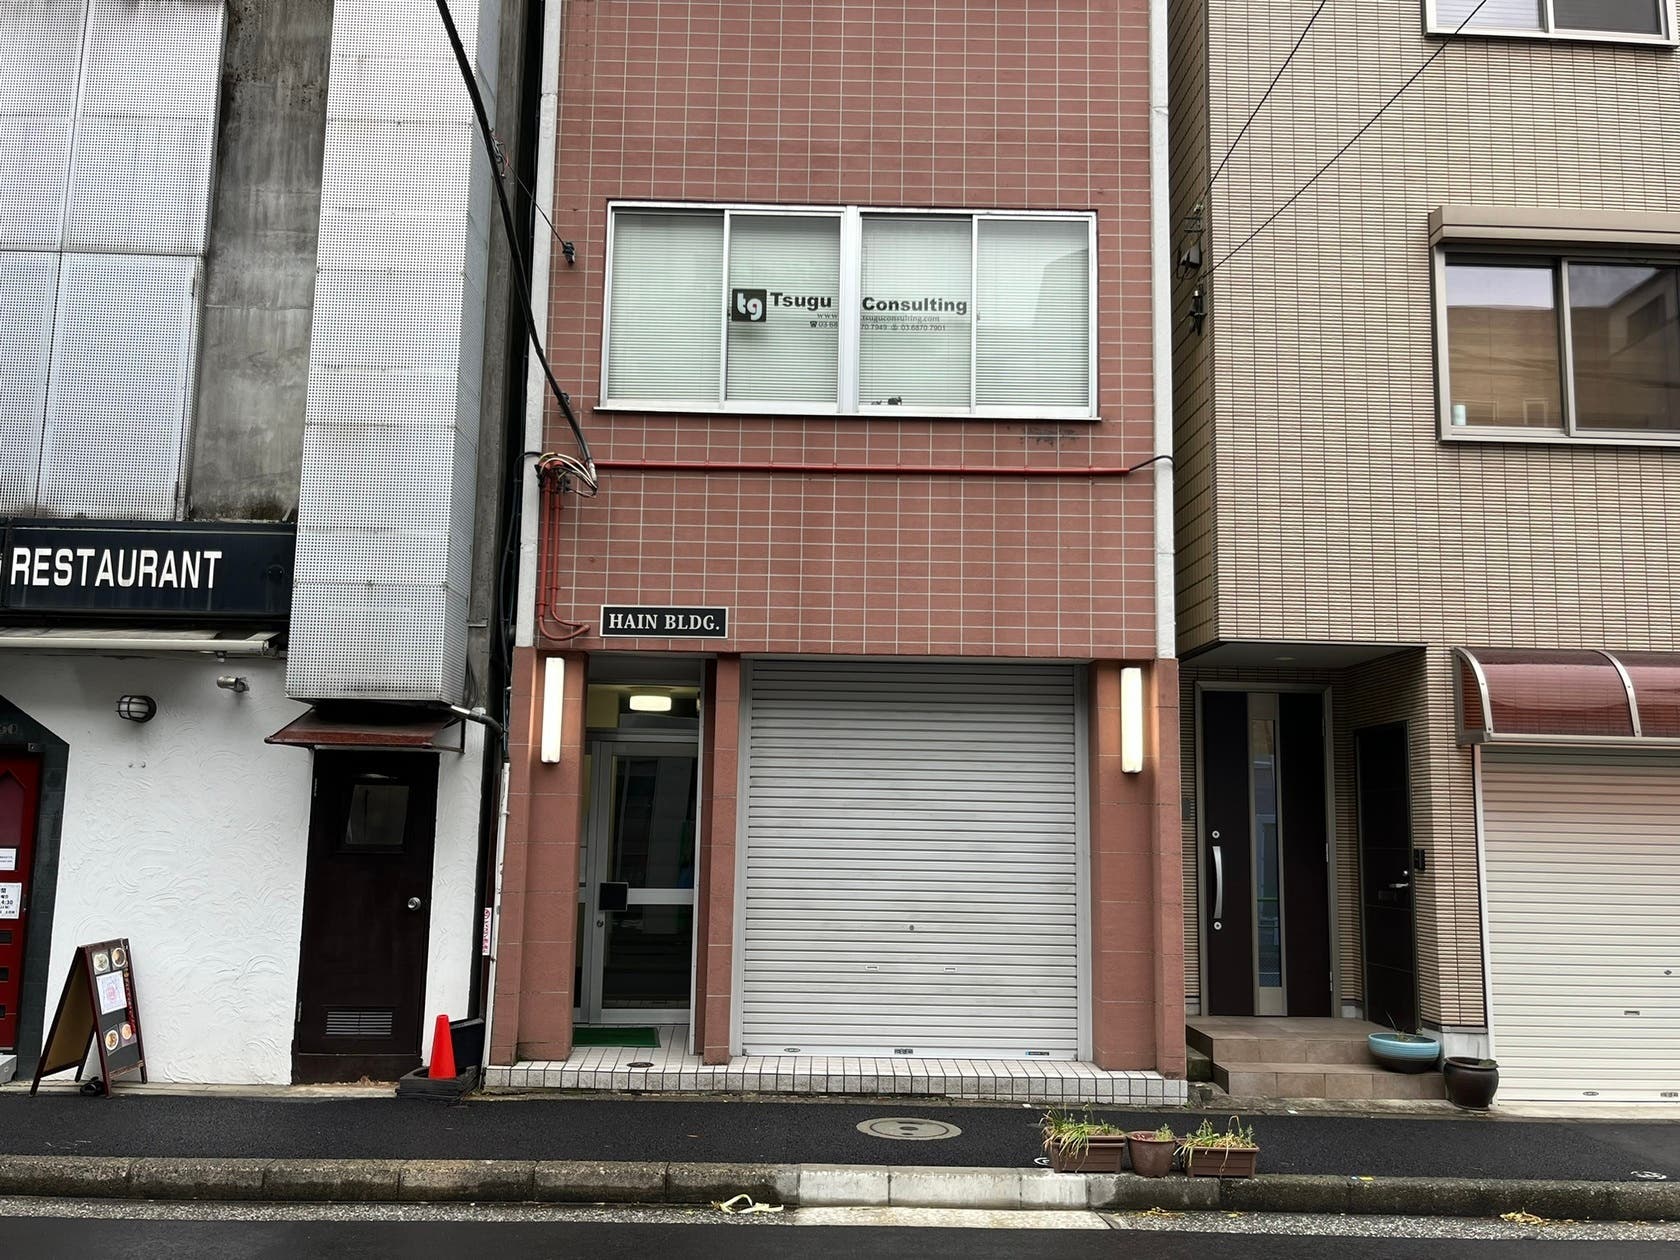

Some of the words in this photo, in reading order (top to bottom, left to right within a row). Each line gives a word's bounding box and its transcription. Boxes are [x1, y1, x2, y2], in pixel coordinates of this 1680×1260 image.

[770, 292, 832, 311] Tsugu
[862, 296, 967, 315] Consulting
[10, 547, 223, 589] RESTAURANT
[608, 613, 658, 630] HAIN
[664, 614, 720, 631] BLDG.
